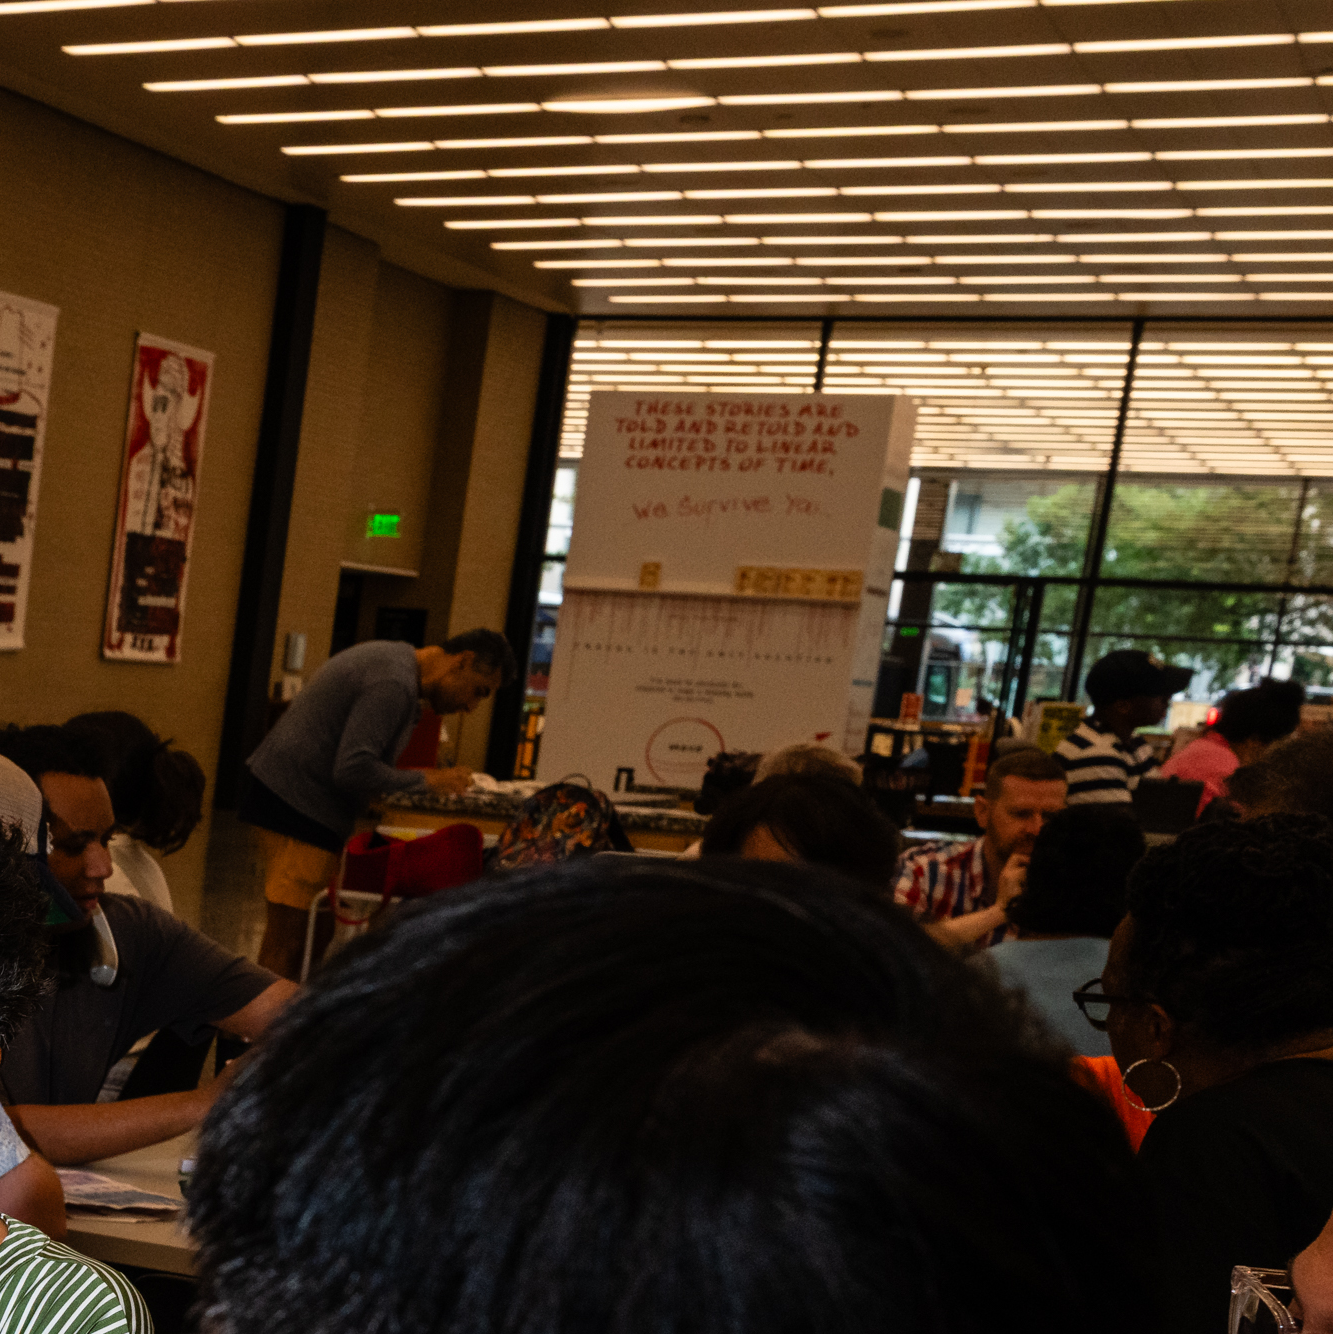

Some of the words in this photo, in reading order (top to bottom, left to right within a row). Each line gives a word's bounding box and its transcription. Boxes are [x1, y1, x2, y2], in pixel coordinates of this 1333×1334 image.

[635, 400, 695, 416] THESE
[704, 401, 791, 418] STORIES
[796, 402, 844, 420] ARE
[615, 417, 668, 434] TOLD
[673, 419, 718, 436] AND
[723, 419, 808, 437] RETOLD
[812, 420, 861, 439] AND
[628, 436, 716, 454] LIMITED
[724, 439, 750, 455] TO
[755, 440, 838, 456] LINEAR
[624, 455, 731, 472] CONCEPTS
[737, 458, 766, 473] OF
